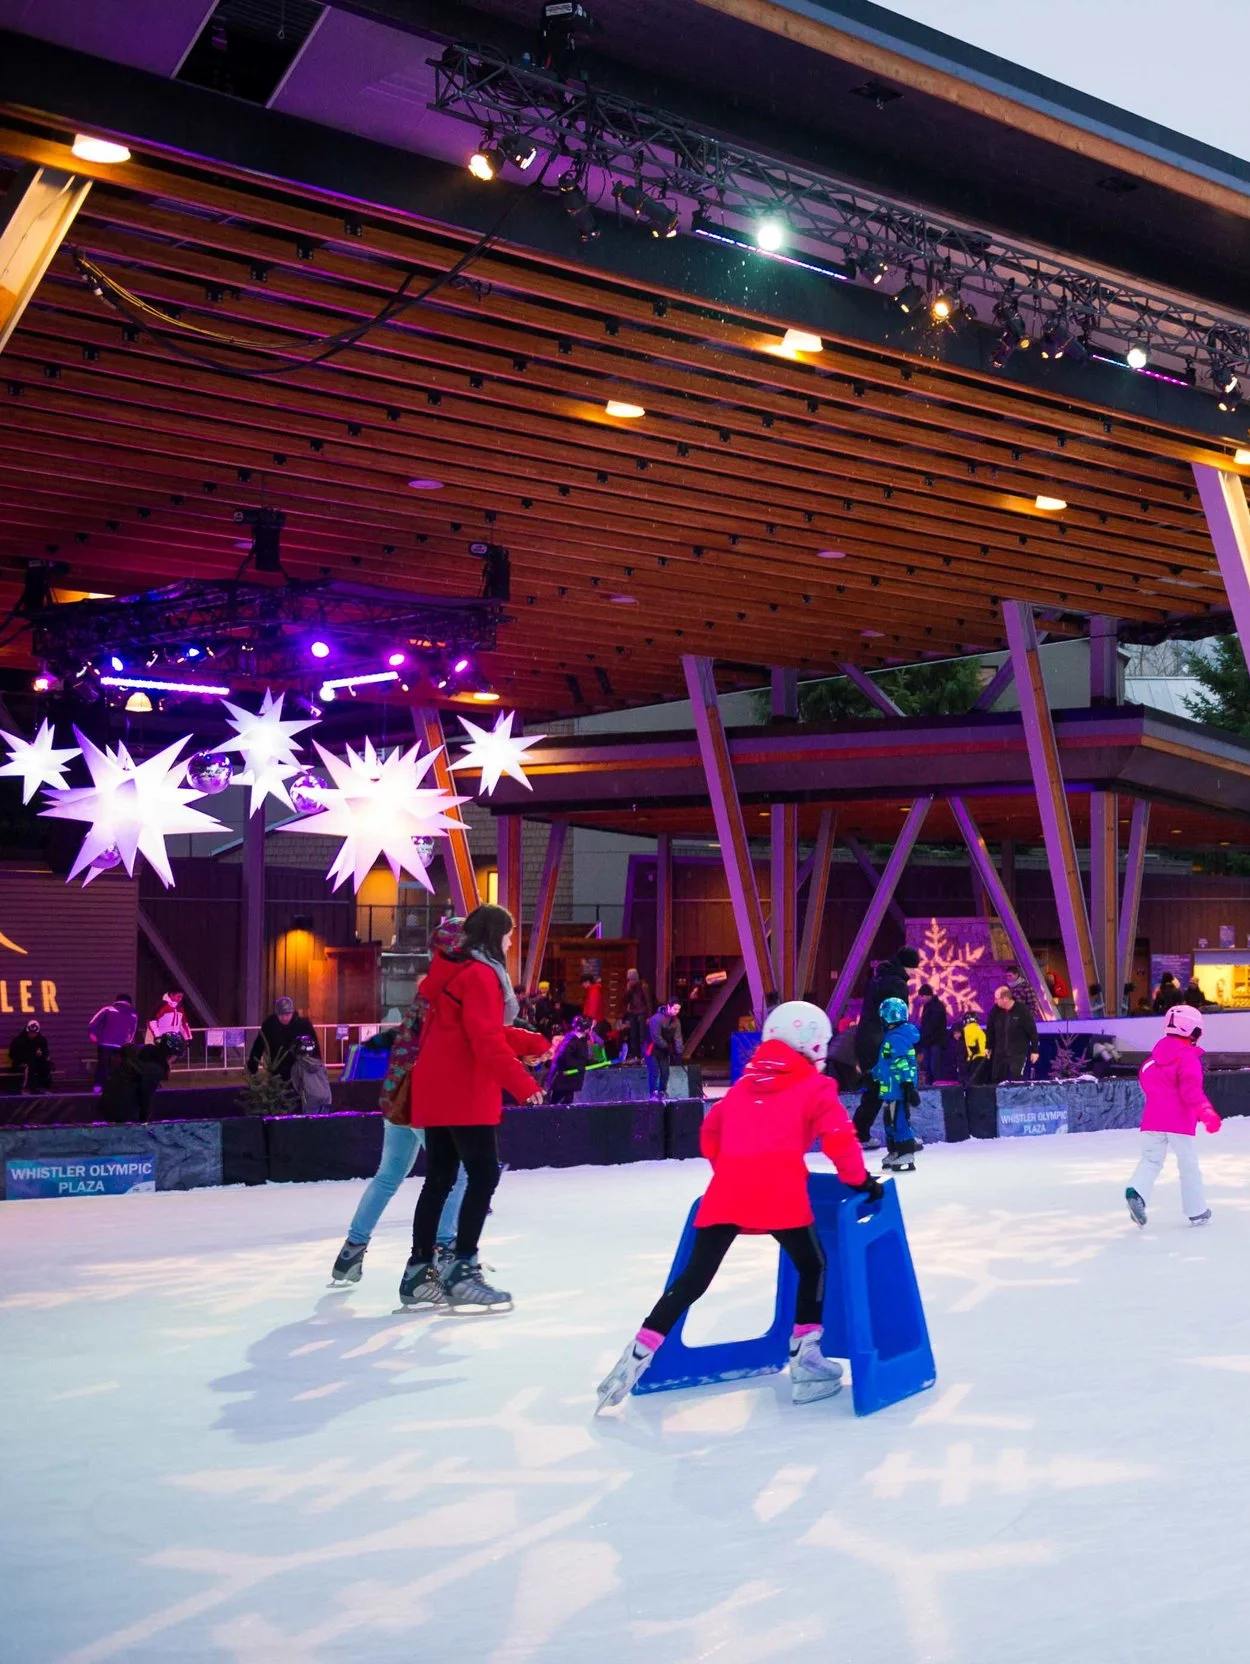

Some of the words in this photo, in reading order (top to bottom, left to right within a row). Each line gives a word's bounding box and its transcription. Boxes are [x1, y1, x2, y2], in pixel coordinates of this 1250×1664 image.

[1001, 1112, 1036, 1124] WHISTLER
[1038, 1111, 1067, 1121] OLYMPIC
[1023, 1124, 1046, 1134] PLAZA
[11, 1165, 85, 1180] WHISTLER
[89, 1163, 152, 1176] OLYMPIC
[58, 1181, 105, 1194] PLAZA
